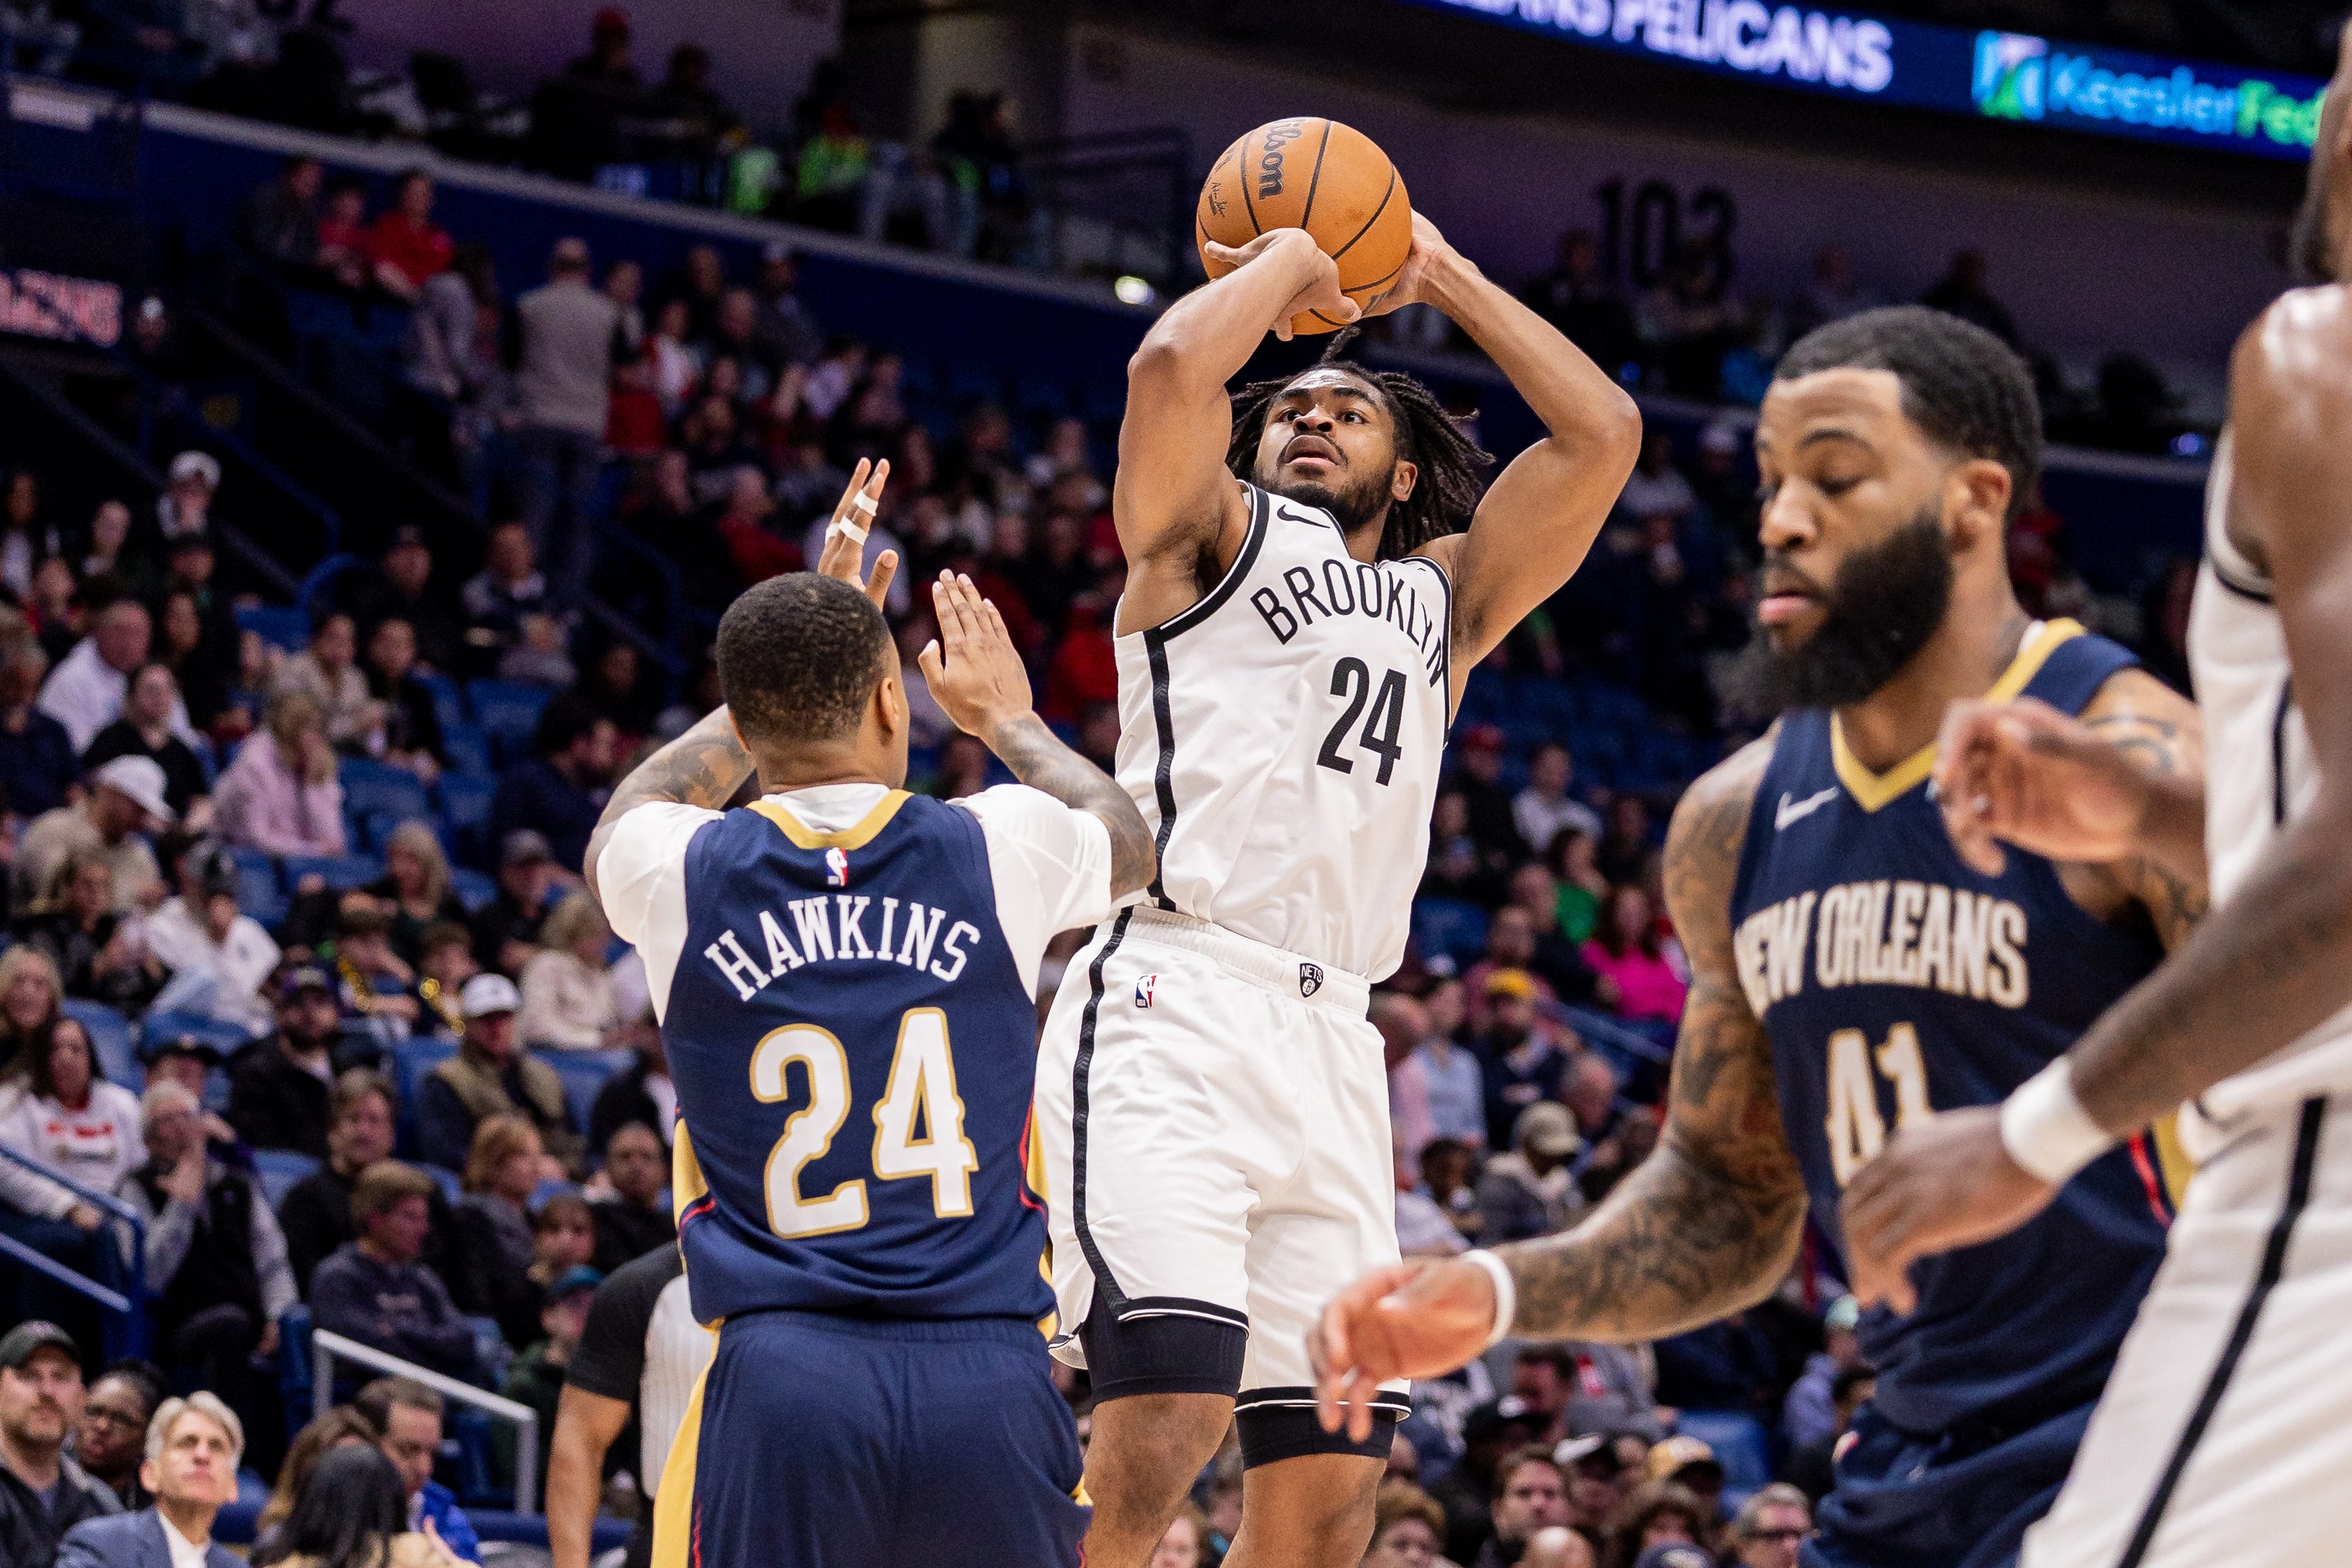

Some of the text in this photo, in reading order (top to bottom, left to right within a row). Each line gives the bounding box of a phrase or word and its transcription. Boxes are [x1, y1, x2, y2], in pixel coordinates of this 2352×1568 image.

[1611, 0, 1893, 93] PELICANS
[1259, 117, 1302, 200] ilson
[1596, 178, 1736, 304] 103
[1250, 559, 1444, 688] BROOKLYN
[1316, 656, 1407, 787] 24
[704, 894, 981, 1002] HAWKINS
[1301, 964, 1323, 983] NETS
[1733, 879, 2030, 1021] EW ORLEANS
[748, 1006, 980, 1240] 24
[1825, 1020, 1934, 1188] 41
